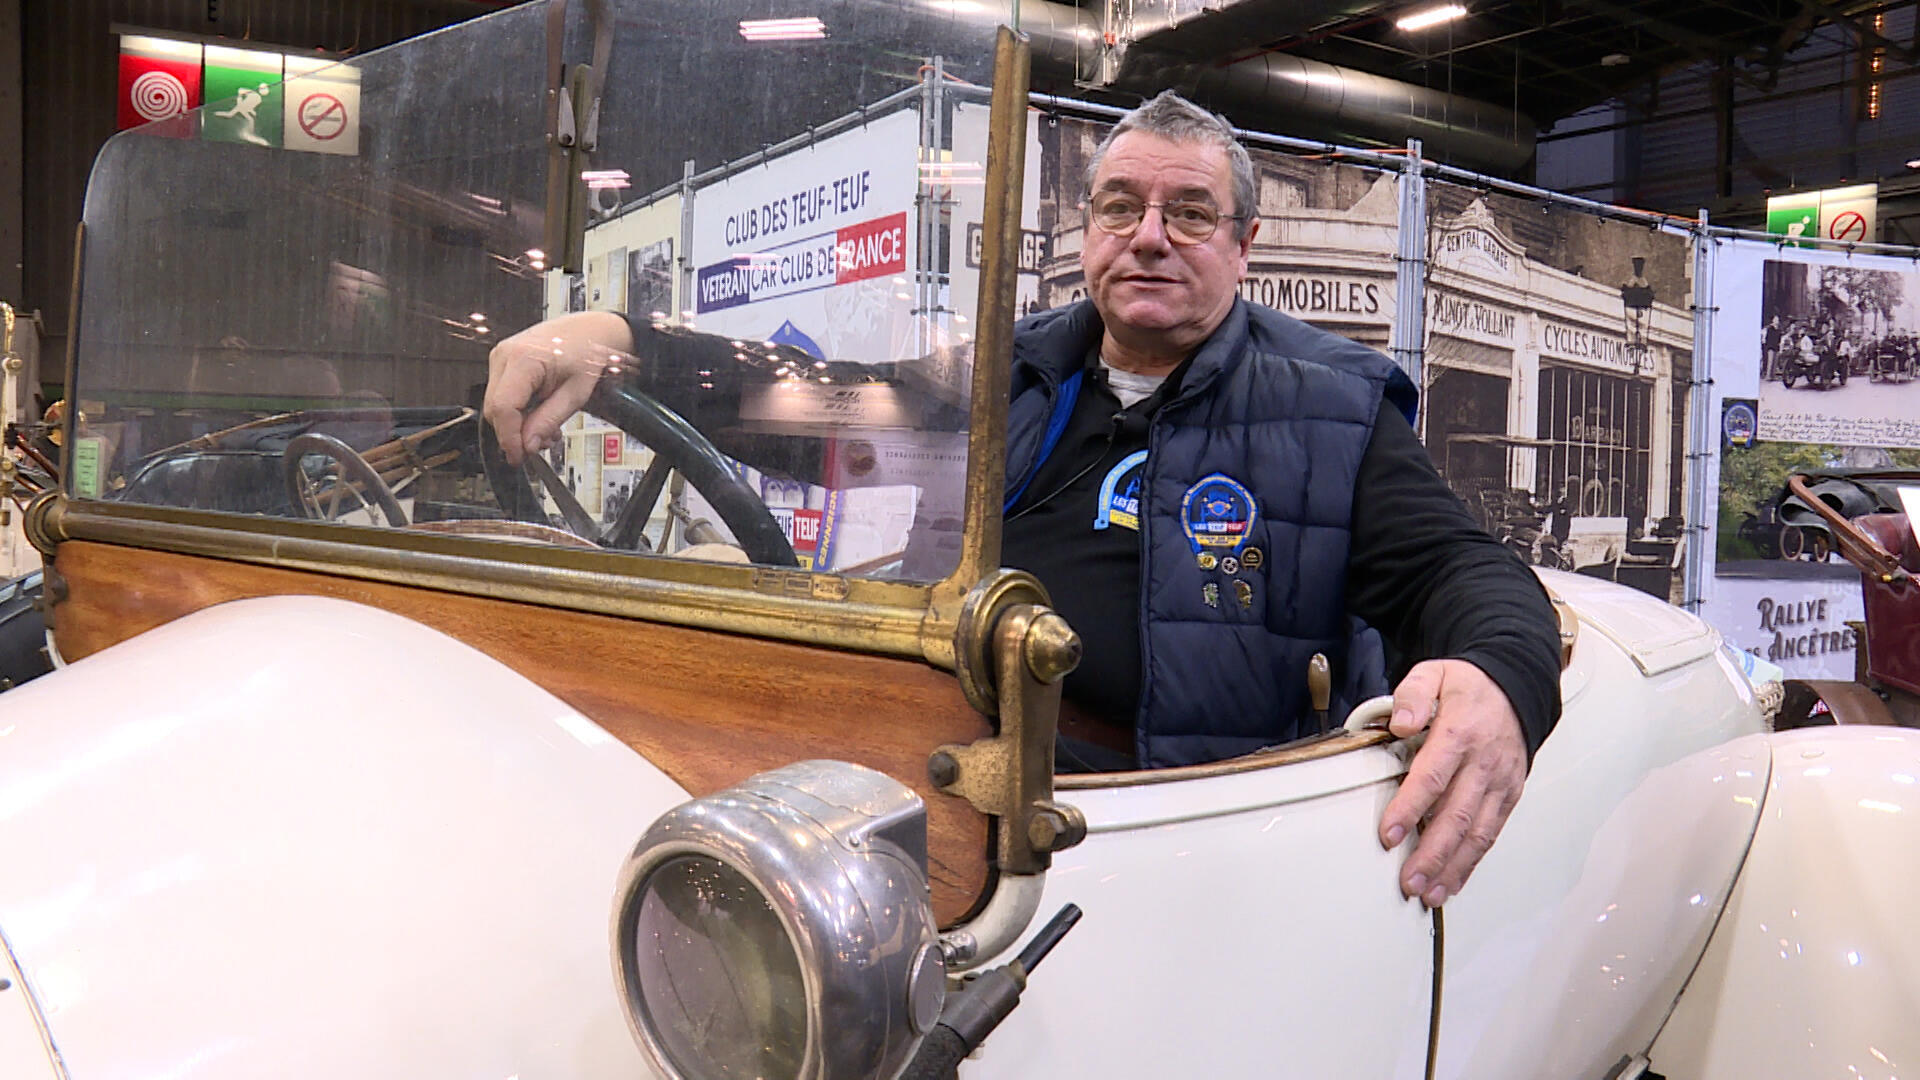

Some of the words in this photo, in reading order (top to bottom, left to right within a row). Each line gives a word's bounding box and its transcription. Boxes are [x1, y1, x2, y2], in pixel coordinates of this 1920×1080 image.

[726, 209, 757, 247] CLUB
[762, 198, 787, 236] DES
[792, 170, 870, 227] TEUF-TEUF
[702, 266, 749, 304] VETERAN
[751, 263, 777, 292] CAR
[780, 250, 813, 284] CLUB
[818, 245, 834, 275] DE
[837, 227, 902, 272] FRANCE
[1447, 231, 1480, 252] CENTRAL
[1483, 235, 1508, 271] GARAGE
[1239, 277, 1379, 314] TOMOBILES
[795, 517, 820, 541] TEUF
[1757, 597, 1827, 633] RALLYE
